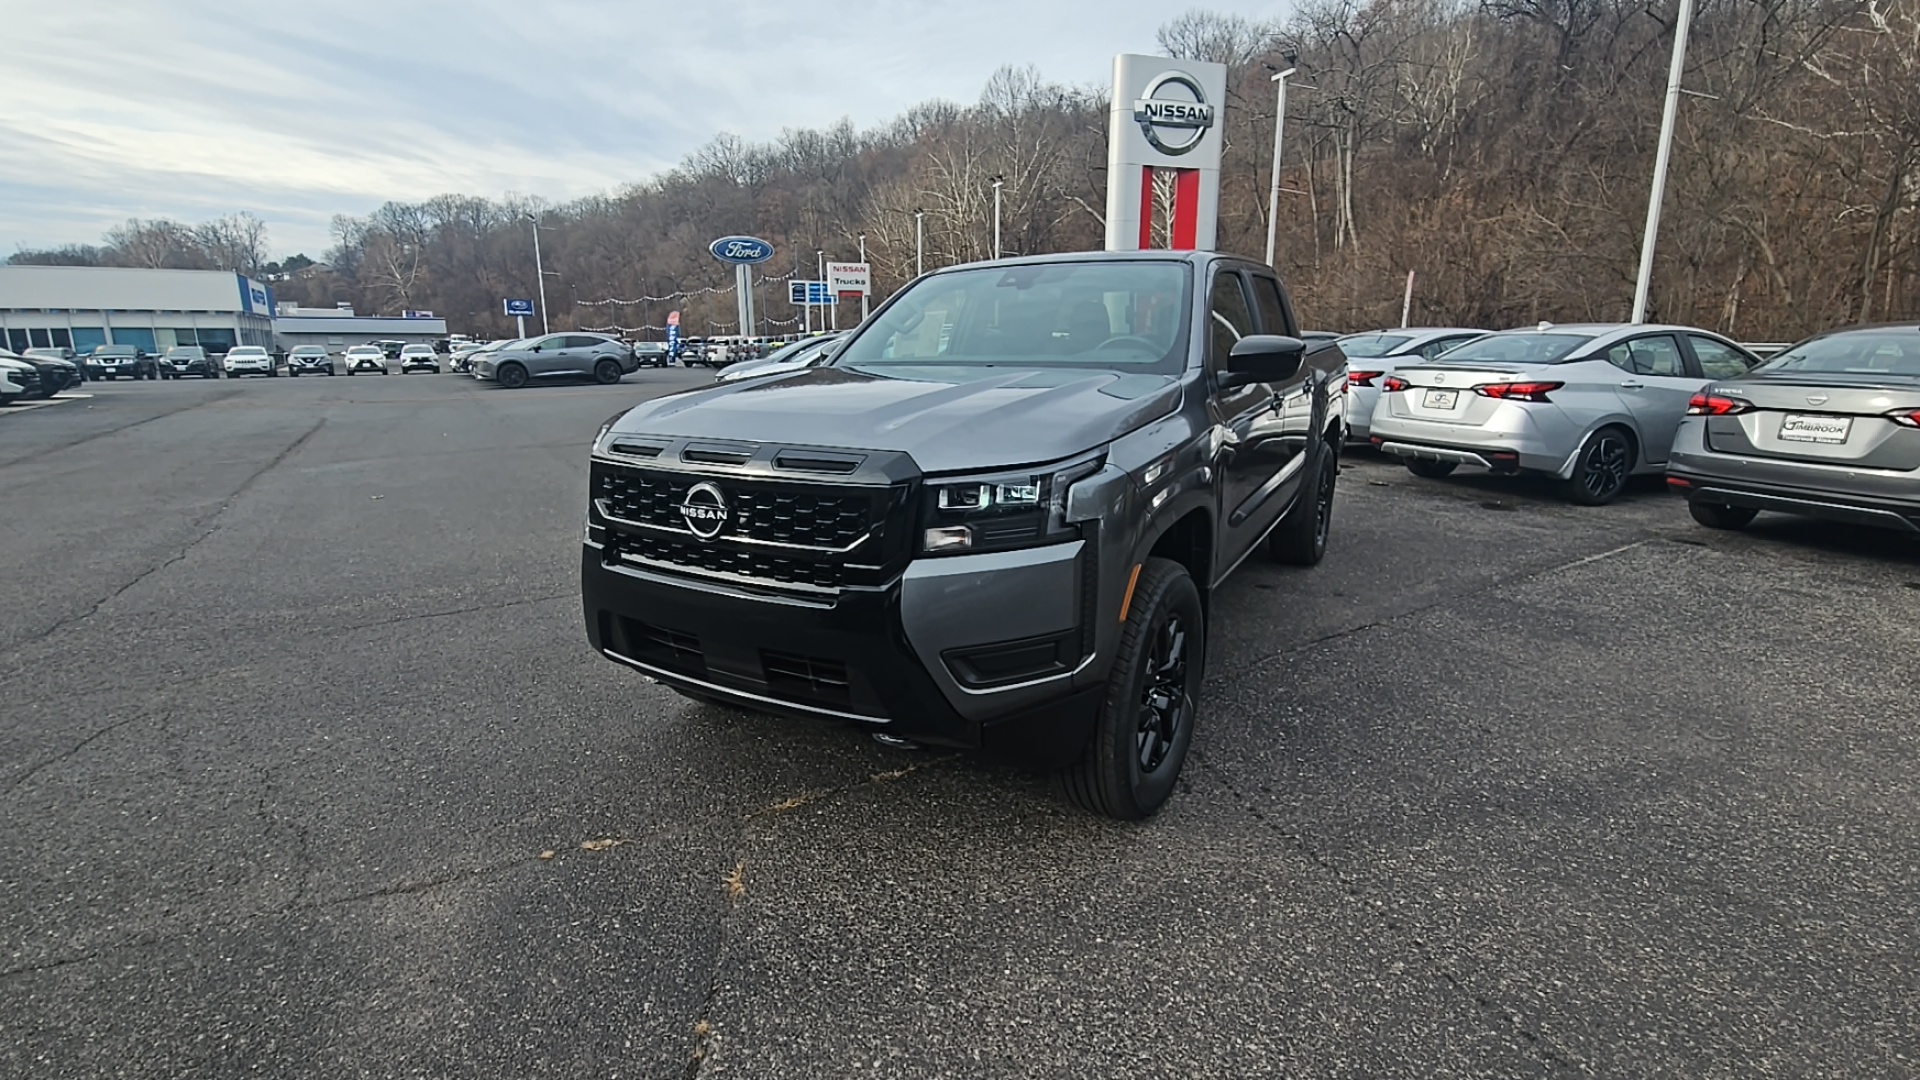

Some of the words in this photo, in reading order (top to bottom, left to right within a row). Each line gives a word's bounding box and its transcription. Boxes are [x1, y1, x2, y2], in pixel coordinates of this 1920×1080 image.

[1144, 103, 1209, 121] NISSAN
[725, 241, 762, 258] Ford
[833, 265, 867, 273] NISSAN
[834, 277, 866, 286] Trucks
[680, 505, 727, 519] NISSAN
